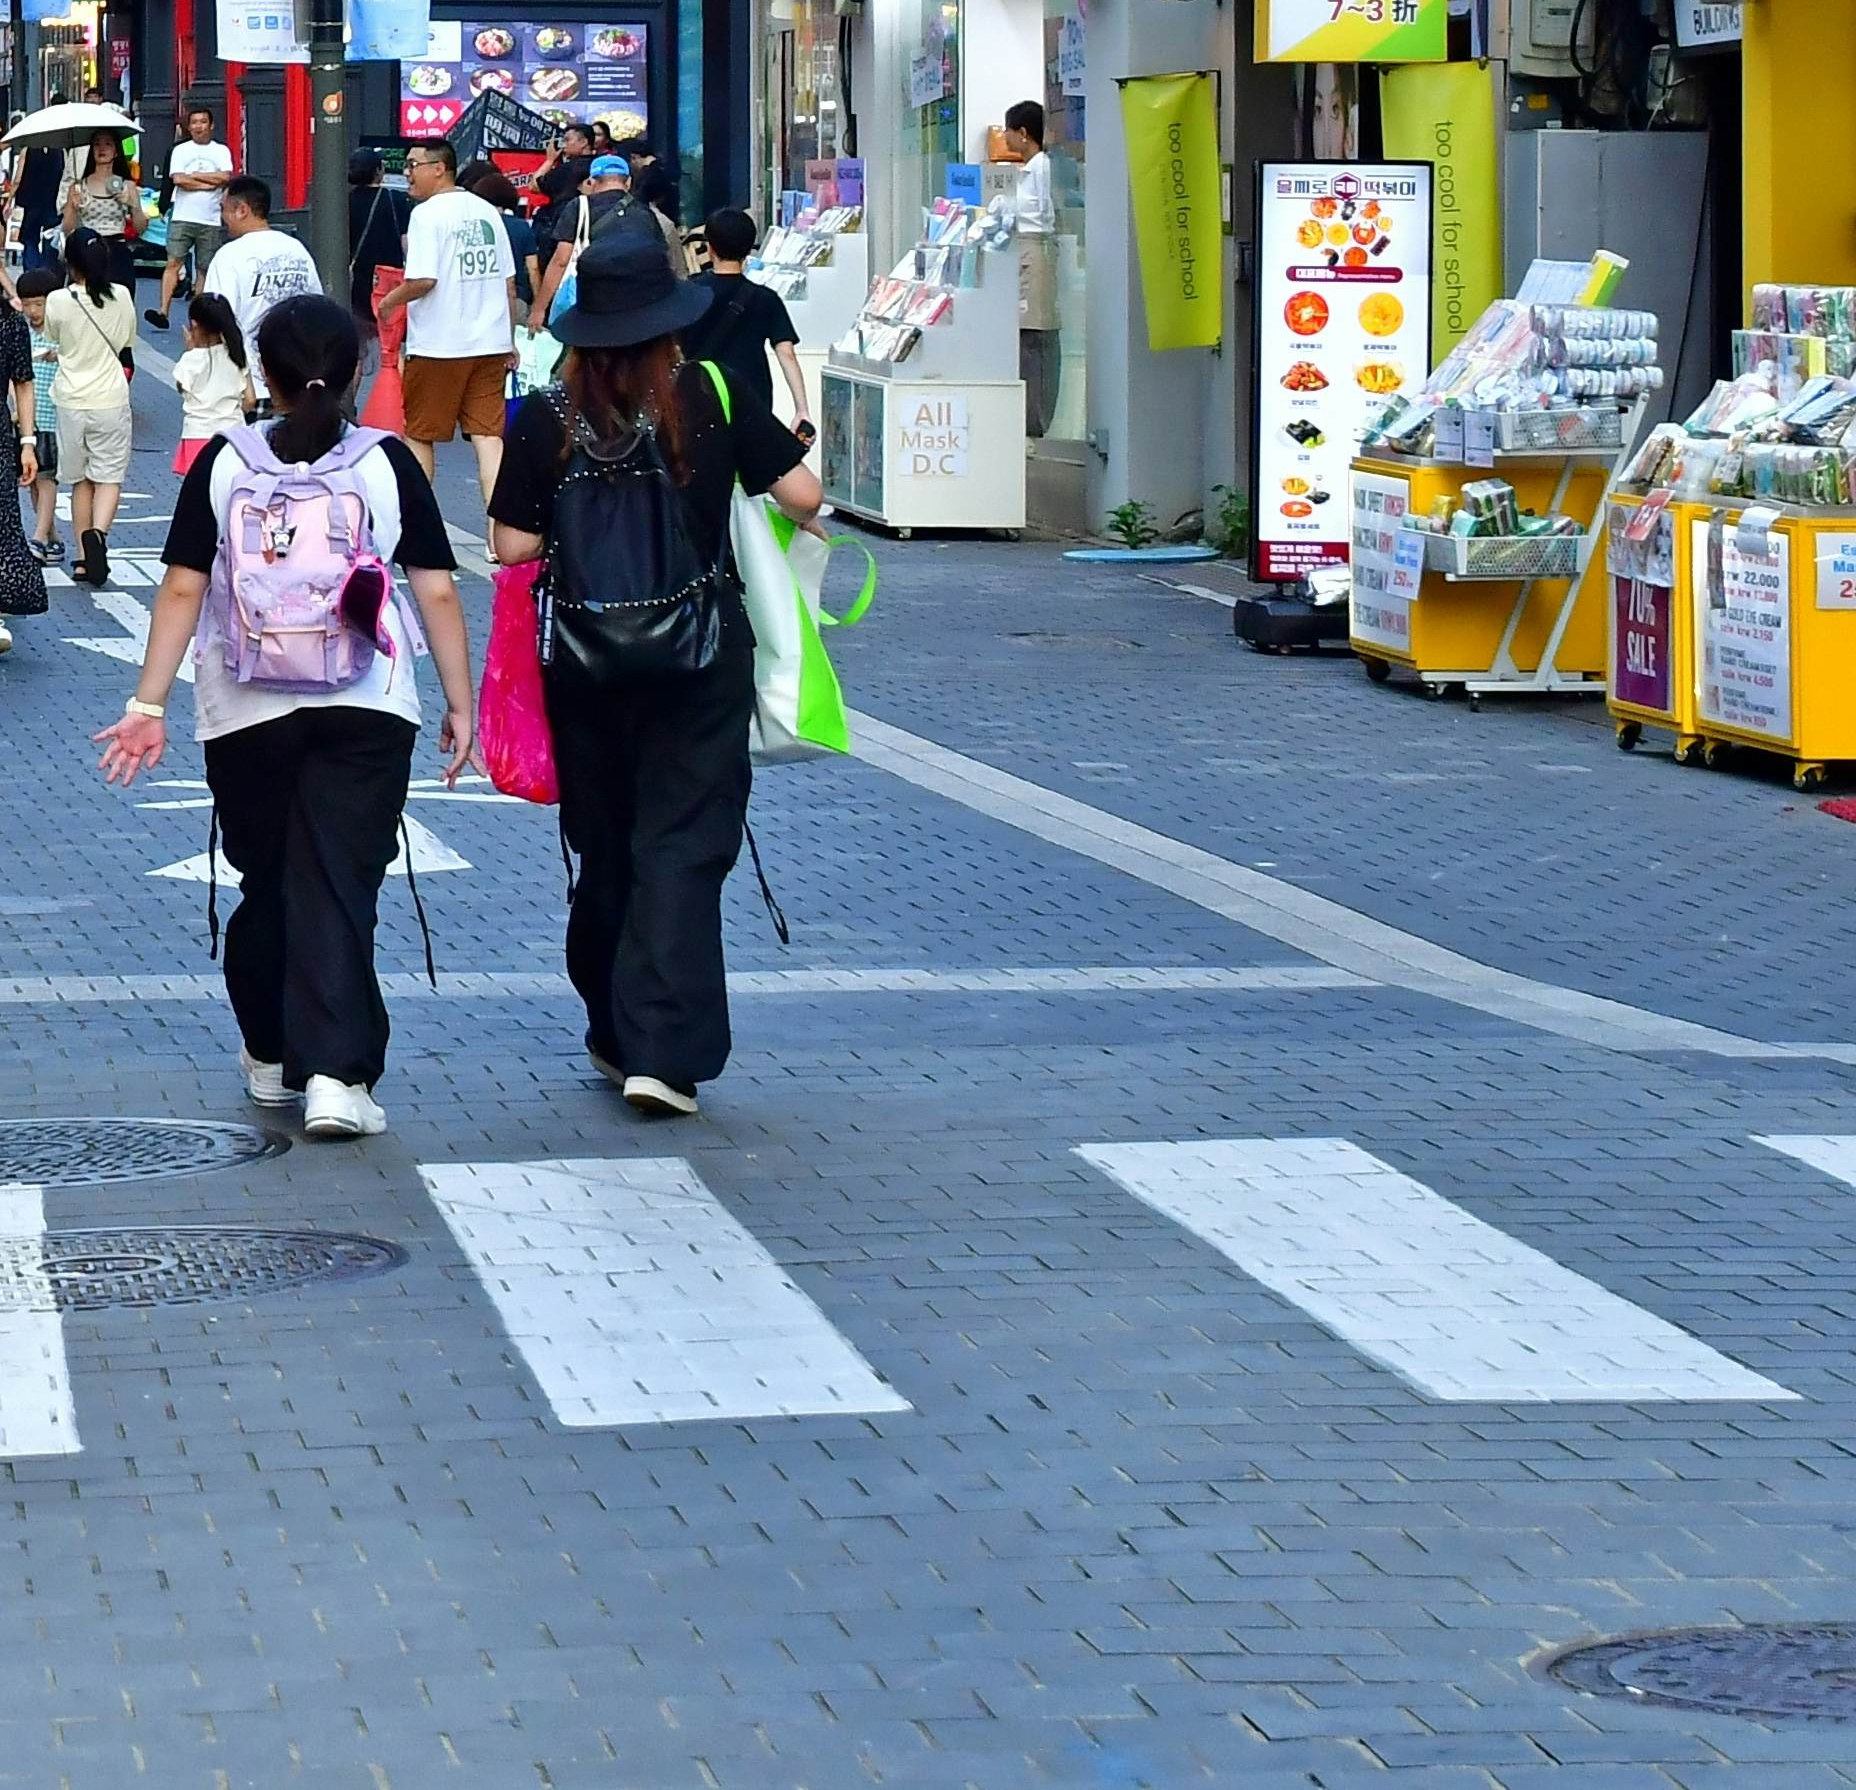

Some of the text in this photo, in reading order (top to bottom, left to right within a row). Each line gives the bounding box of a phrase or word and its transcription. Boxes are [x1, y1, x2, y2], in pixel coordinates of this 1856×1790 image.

[1167, 121, 1183, 154] too
[1171, 159, 1190, 199] cool
[1175, 205, 1192, 230] for
[1434, 120, 1468, 335] too cool for school
[456, 249, 500, 277] 1992
[1177, 237, 1200, 301] school
[914, 401, 952, 427] All
[900, 427, 960, 449] Mask
[911, 452, 956, 475] D.C
[1626, 630, 1657, 678] SALE
